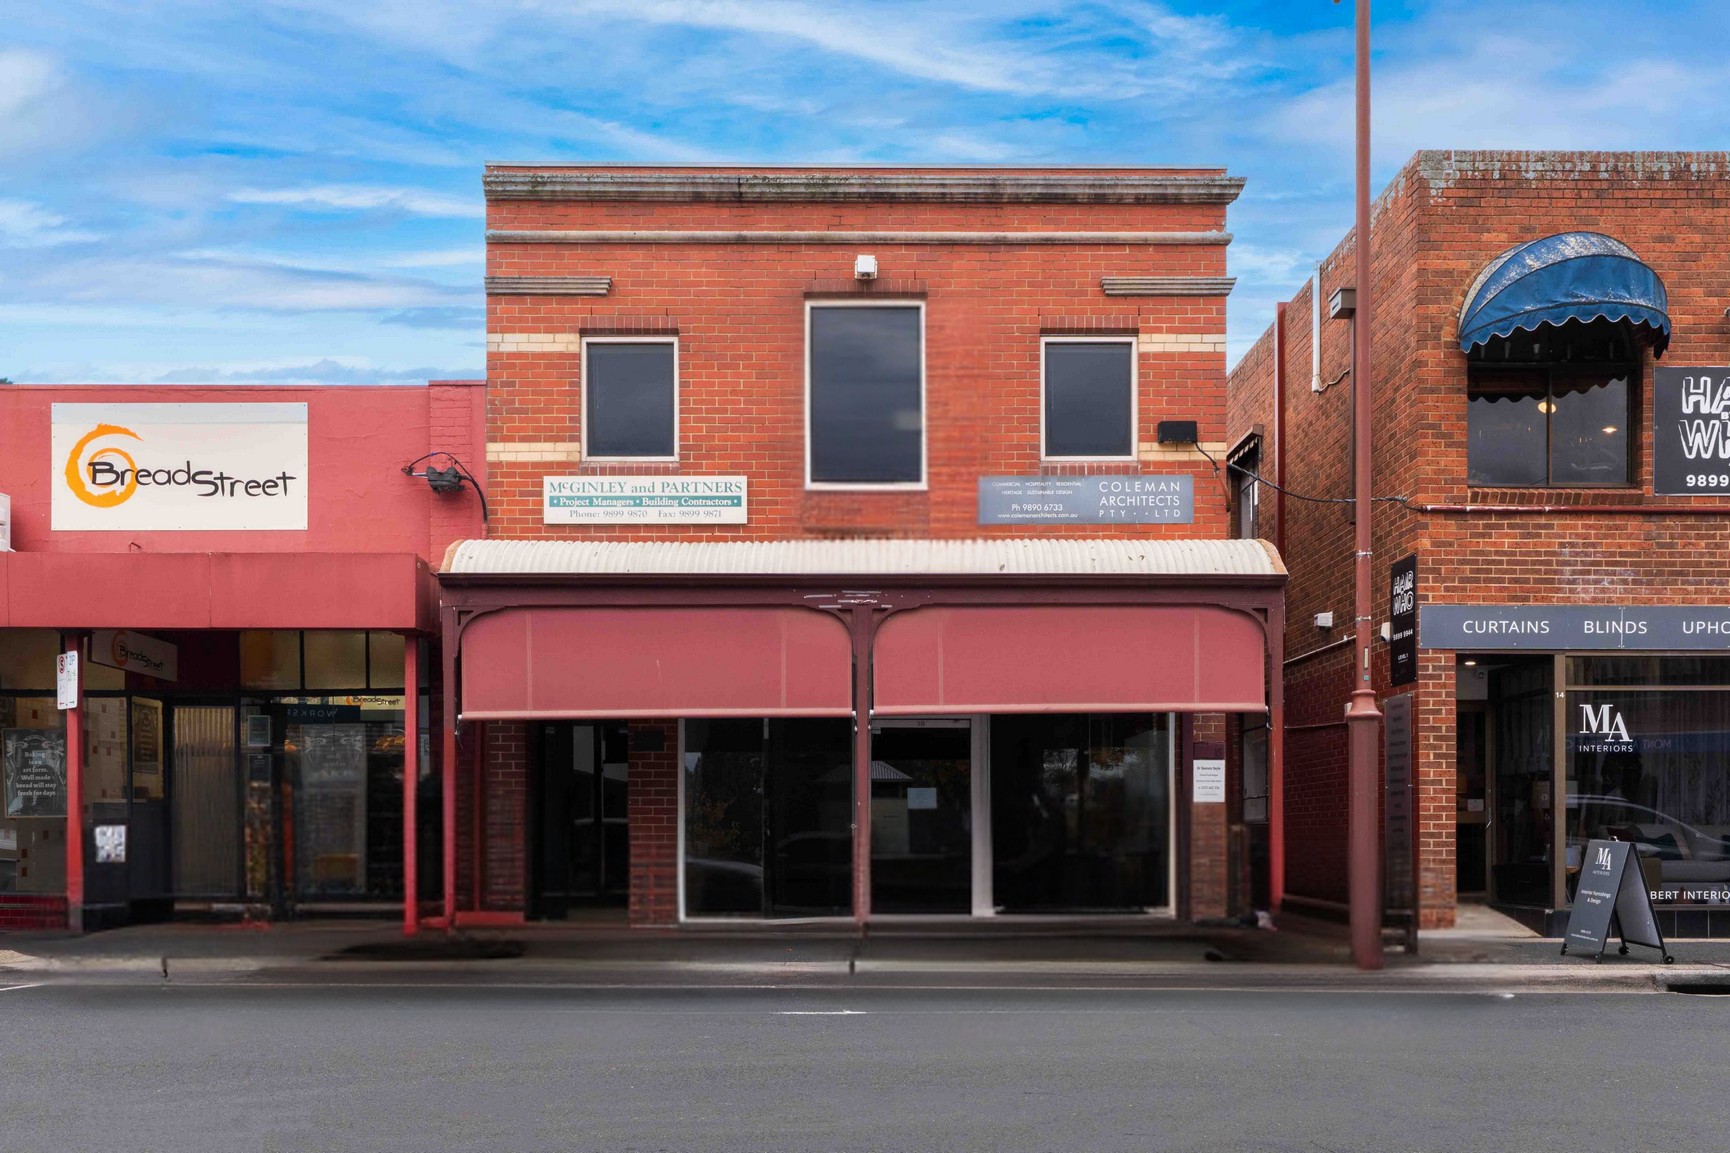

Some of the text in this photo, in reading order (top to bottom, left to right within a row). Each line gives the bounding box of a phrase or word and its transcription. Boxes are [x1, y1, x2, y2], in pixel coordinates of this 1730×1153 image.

[1686, 474, 1730, 487] 9899
[549, 481, 742, 493] McGINLEY and PARTNERS
[1099, 481, 1180, 493] COLEMAN
[560, 497, 732, 507] Project Managers Building Contractors
[1011, 503, 1063, 511] Ph 9890 6733
[1099, 495, 1180, 507] ARCHITECTS
[570, 509, 722, 518] Phone: 9899 9870 Fax: 9899 9871
[1099, 509, 1181, 518] PTY LTD
[1392, 570, 1414, 595] HAIR
[1392, 590, 1414, 616] WHO
[1463, 620, 1550, 634] CURTAINS
[1583, 620, 1648, 634] BLINDS
[1579, 704, 1633, 742] MA
[1579, 744, 1633, 752] INTERIORS
[1683, 890, 1730, 900] INTERIO
